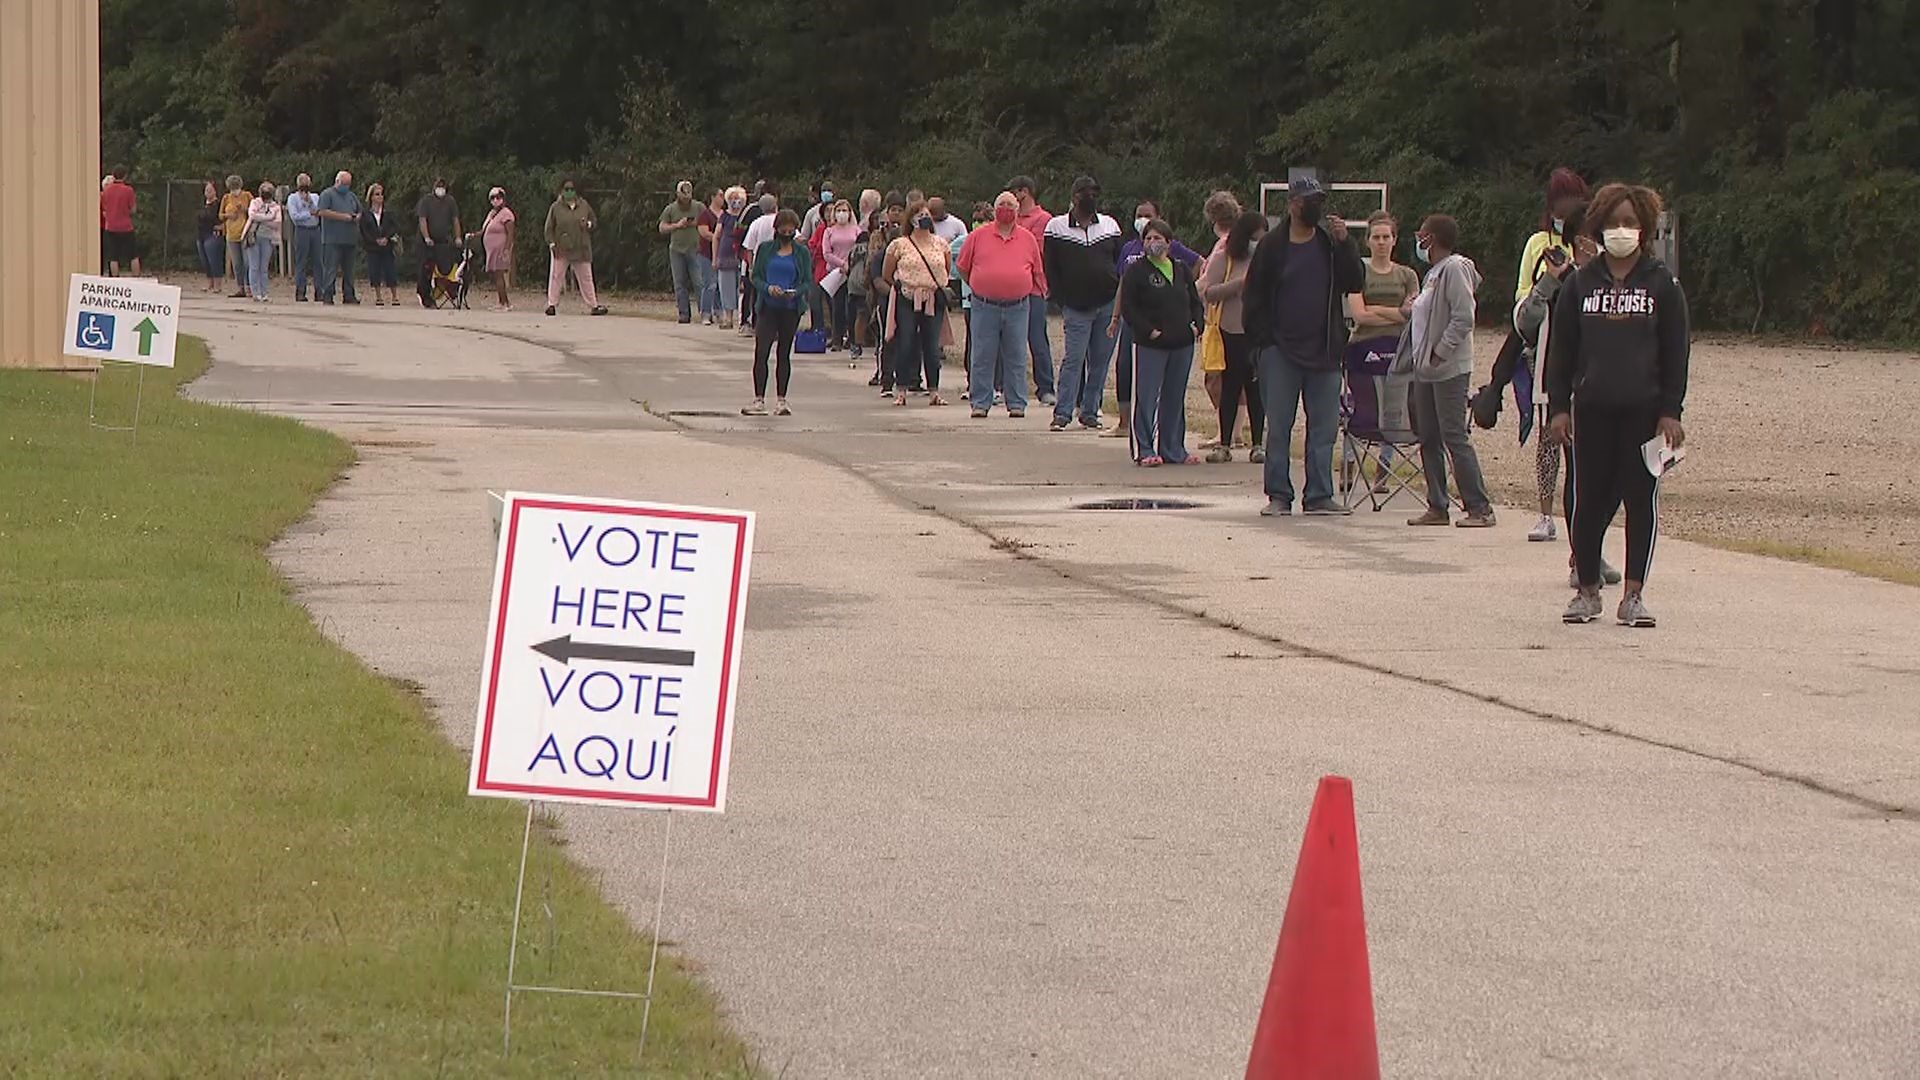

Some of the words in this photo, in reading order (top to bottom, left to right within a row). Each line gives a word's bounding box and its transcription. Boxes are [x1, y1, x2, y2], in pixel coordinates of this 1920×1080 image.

[80, 296, 171, 315] APARCAMIENTO
[81, 283, 132, 297] PARKING
[1583, 296, 1600, 312] NO
[557, 523, 699, 572] VOTE
[551, 585, 685, 634] HERE
[540, 667, 682, 716] VOTE
[527, 725, 676, 782] AQUÍ
